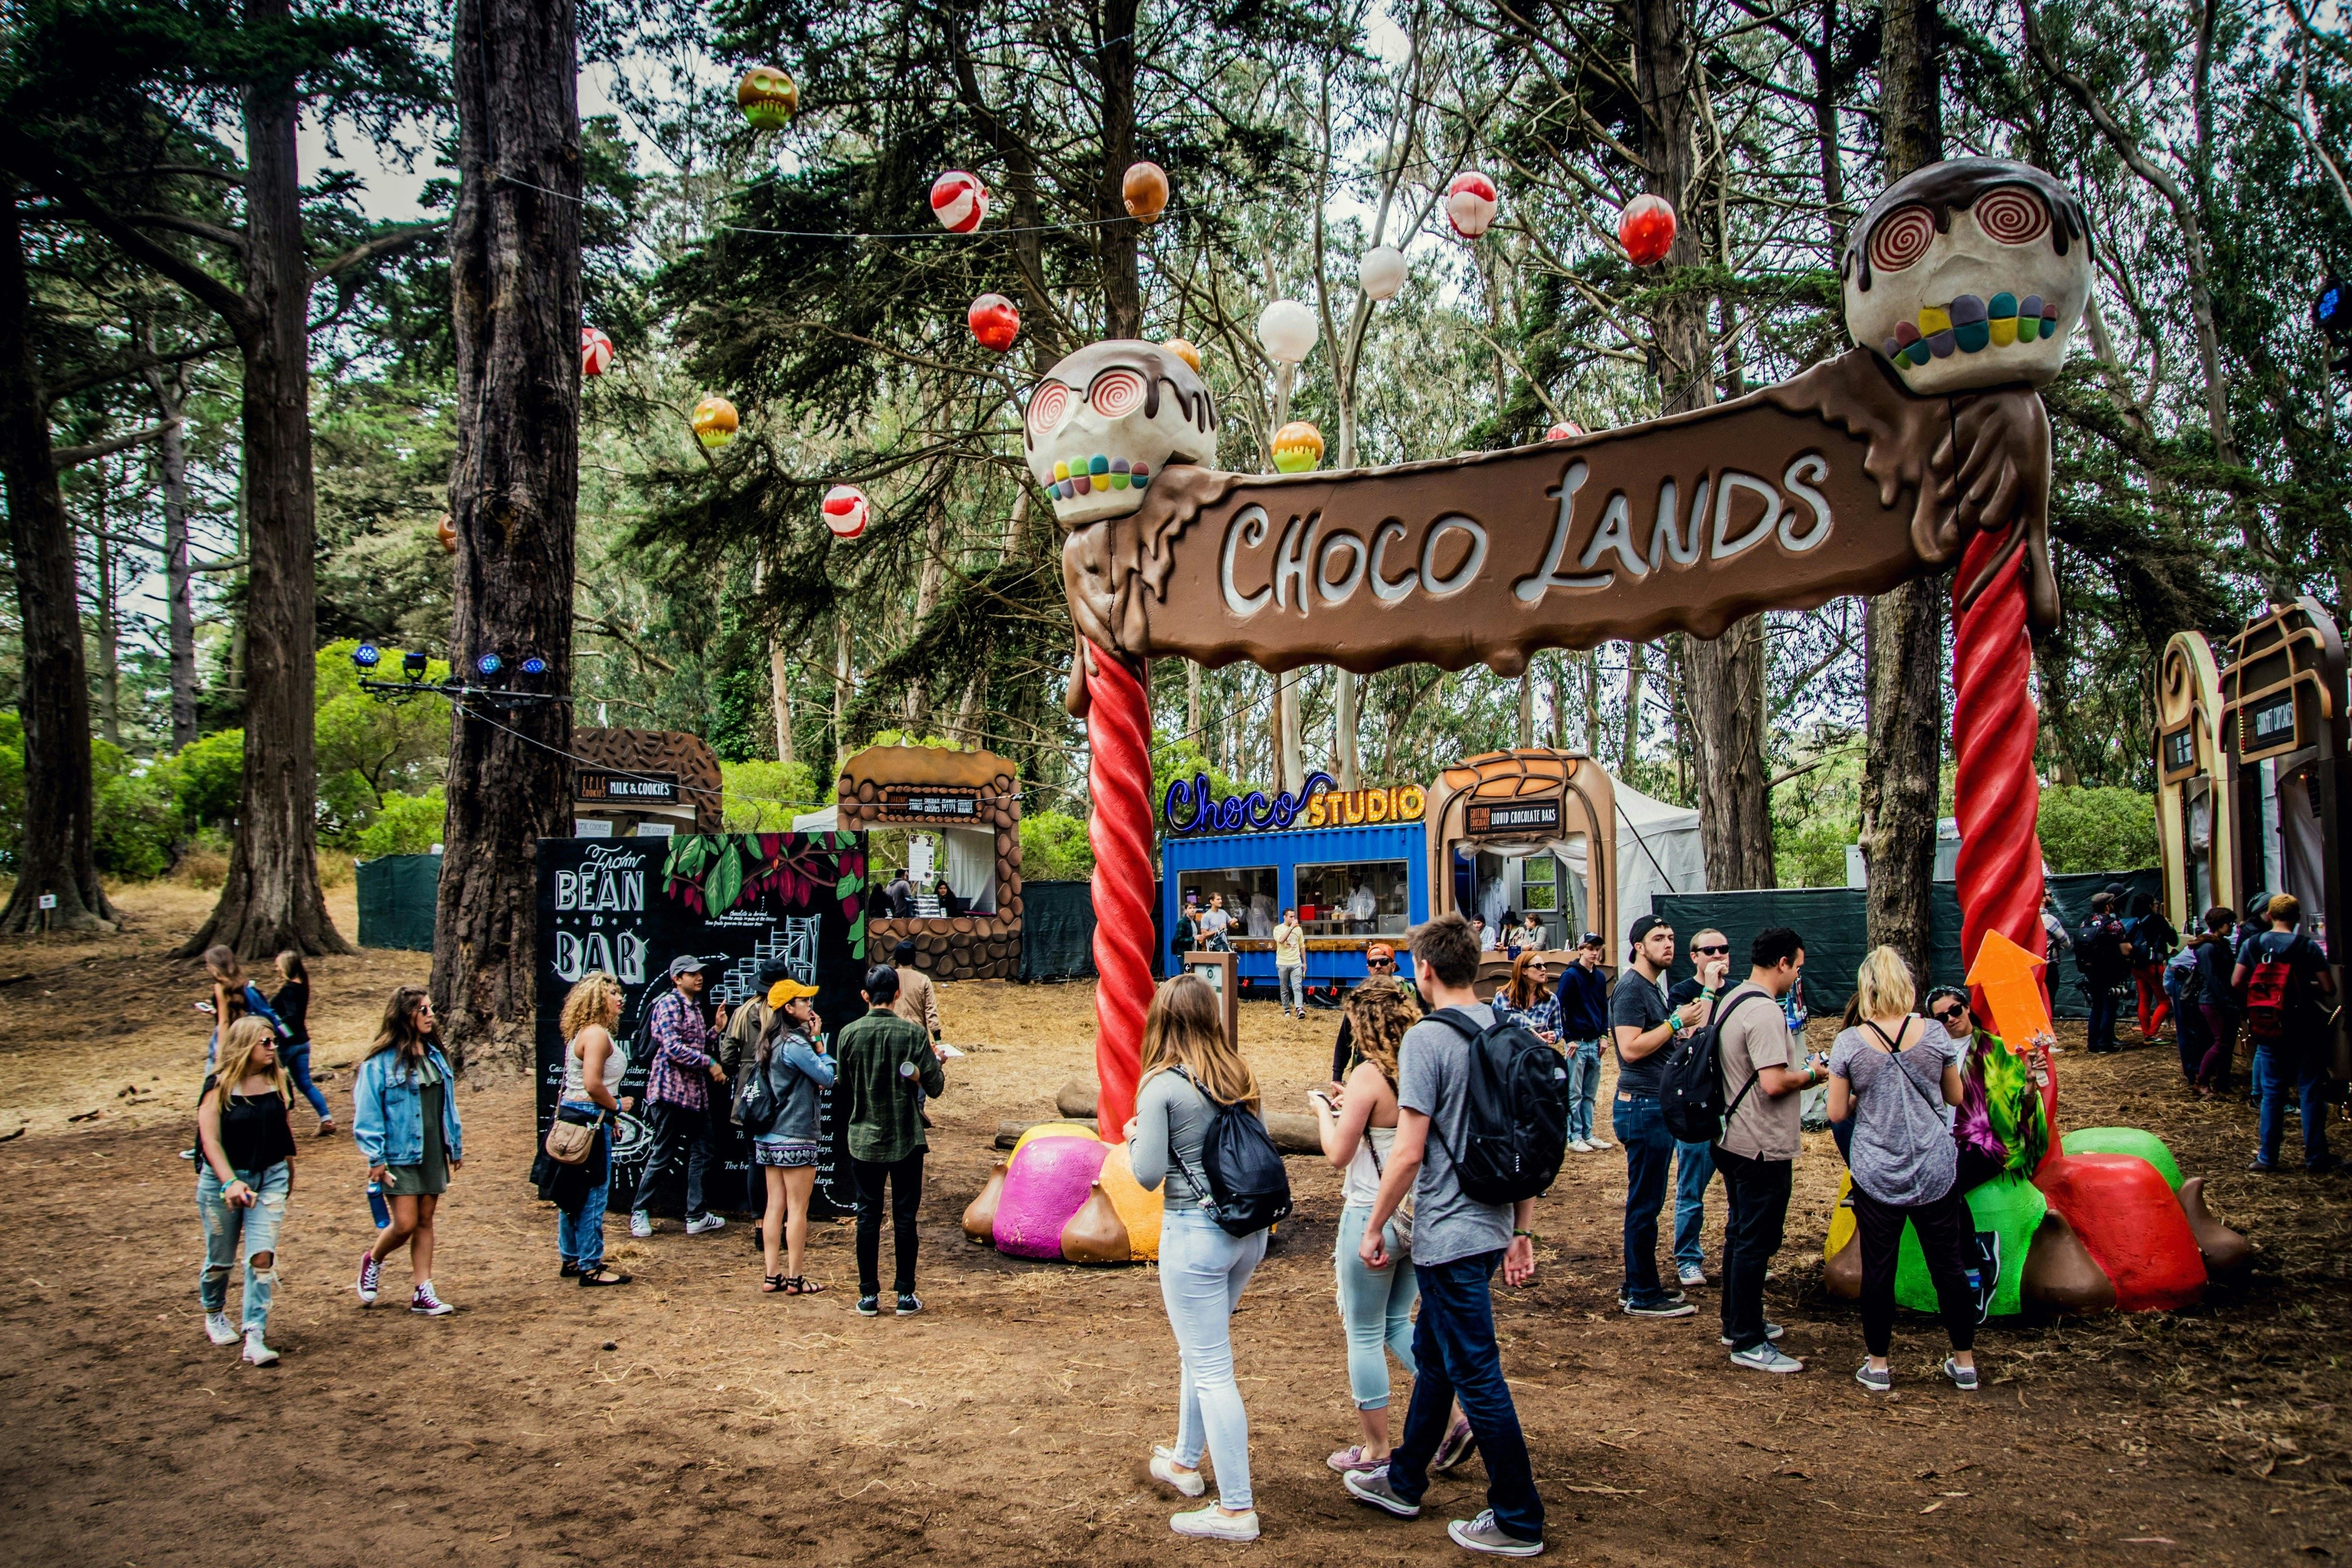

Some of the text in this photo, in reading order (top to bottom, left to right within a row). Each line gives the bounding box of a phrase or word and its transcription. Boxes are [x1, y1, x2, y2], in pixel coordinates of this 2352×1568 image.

[1219, 504, 1488, 615] CHOCO
[582, 776, 605, 789] EPIC
[610, 782, 670, 796] MILK & COOKIES
[1164, 771, 1427, 836] Choco STUDIO
[1492, 809, 1555, 825] LIQUID CHOCOLATE BARS
[579, 844, 646, 872] From
[556, 870, 644, 911] BEAN
[591, 914, 603, 927] to
[556, 931, 646, 985] BAR
[626, 1065, 647, 1074] either
[547, 1076, 558, 1084] the
[620, 1078, 645, 1086] climate
[816, 1143, 832, 1155] days.
[724, 1161, 738, 1169] The
[814, 1175, 834, 1187] days.
